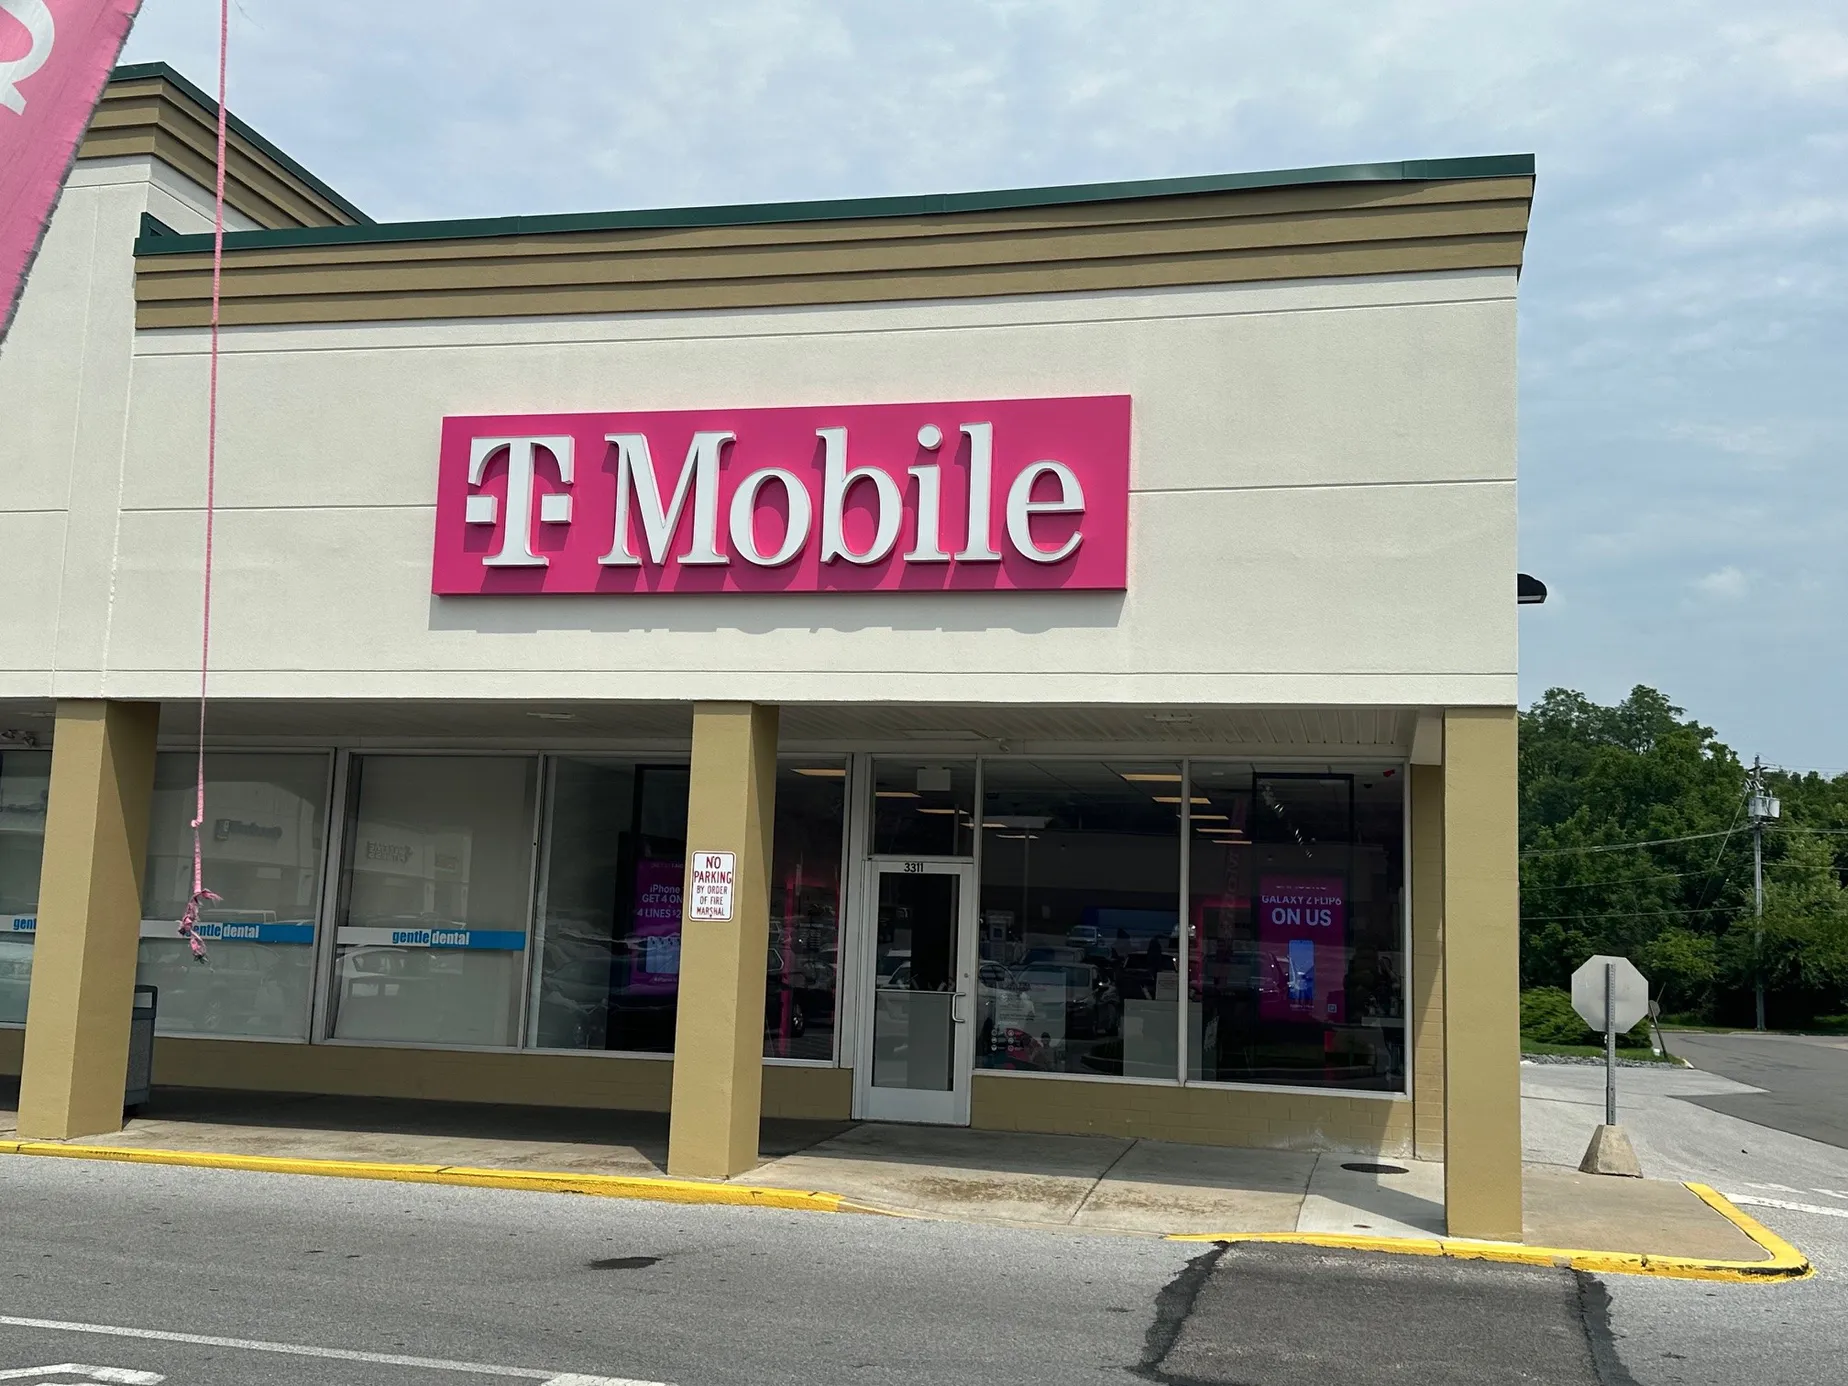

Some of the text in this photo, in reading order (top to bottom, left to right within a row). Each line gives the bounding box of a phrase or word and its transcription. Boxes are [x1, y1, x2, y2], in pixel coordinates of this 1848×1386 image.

[597, 420, 1086, 567] Mobile
[705, 855, 722, 869] NO
[903, 862, 924, 873] 3311
[693, 870, 732, 884] PARKING
[649, 883, 681, 894] iPhone
[696, 885, 728, 895] BY ORDER
[641, 893, 660, 903] GET
[661, 894, 668, 904] 4
[699, 896, 724, 906] OF FIRE
[1261, 894, 1304, 905] GALAXY
[636, 908, 643, 917] 4
[645, 908, 671, 918] LINES
[696, 906, 725, 916] MARSHAL
[1271, 907, 1332, 927] ON US
[184, 923, 260, 938] entle dental
[392, 930, 470, 945] gentle dental
